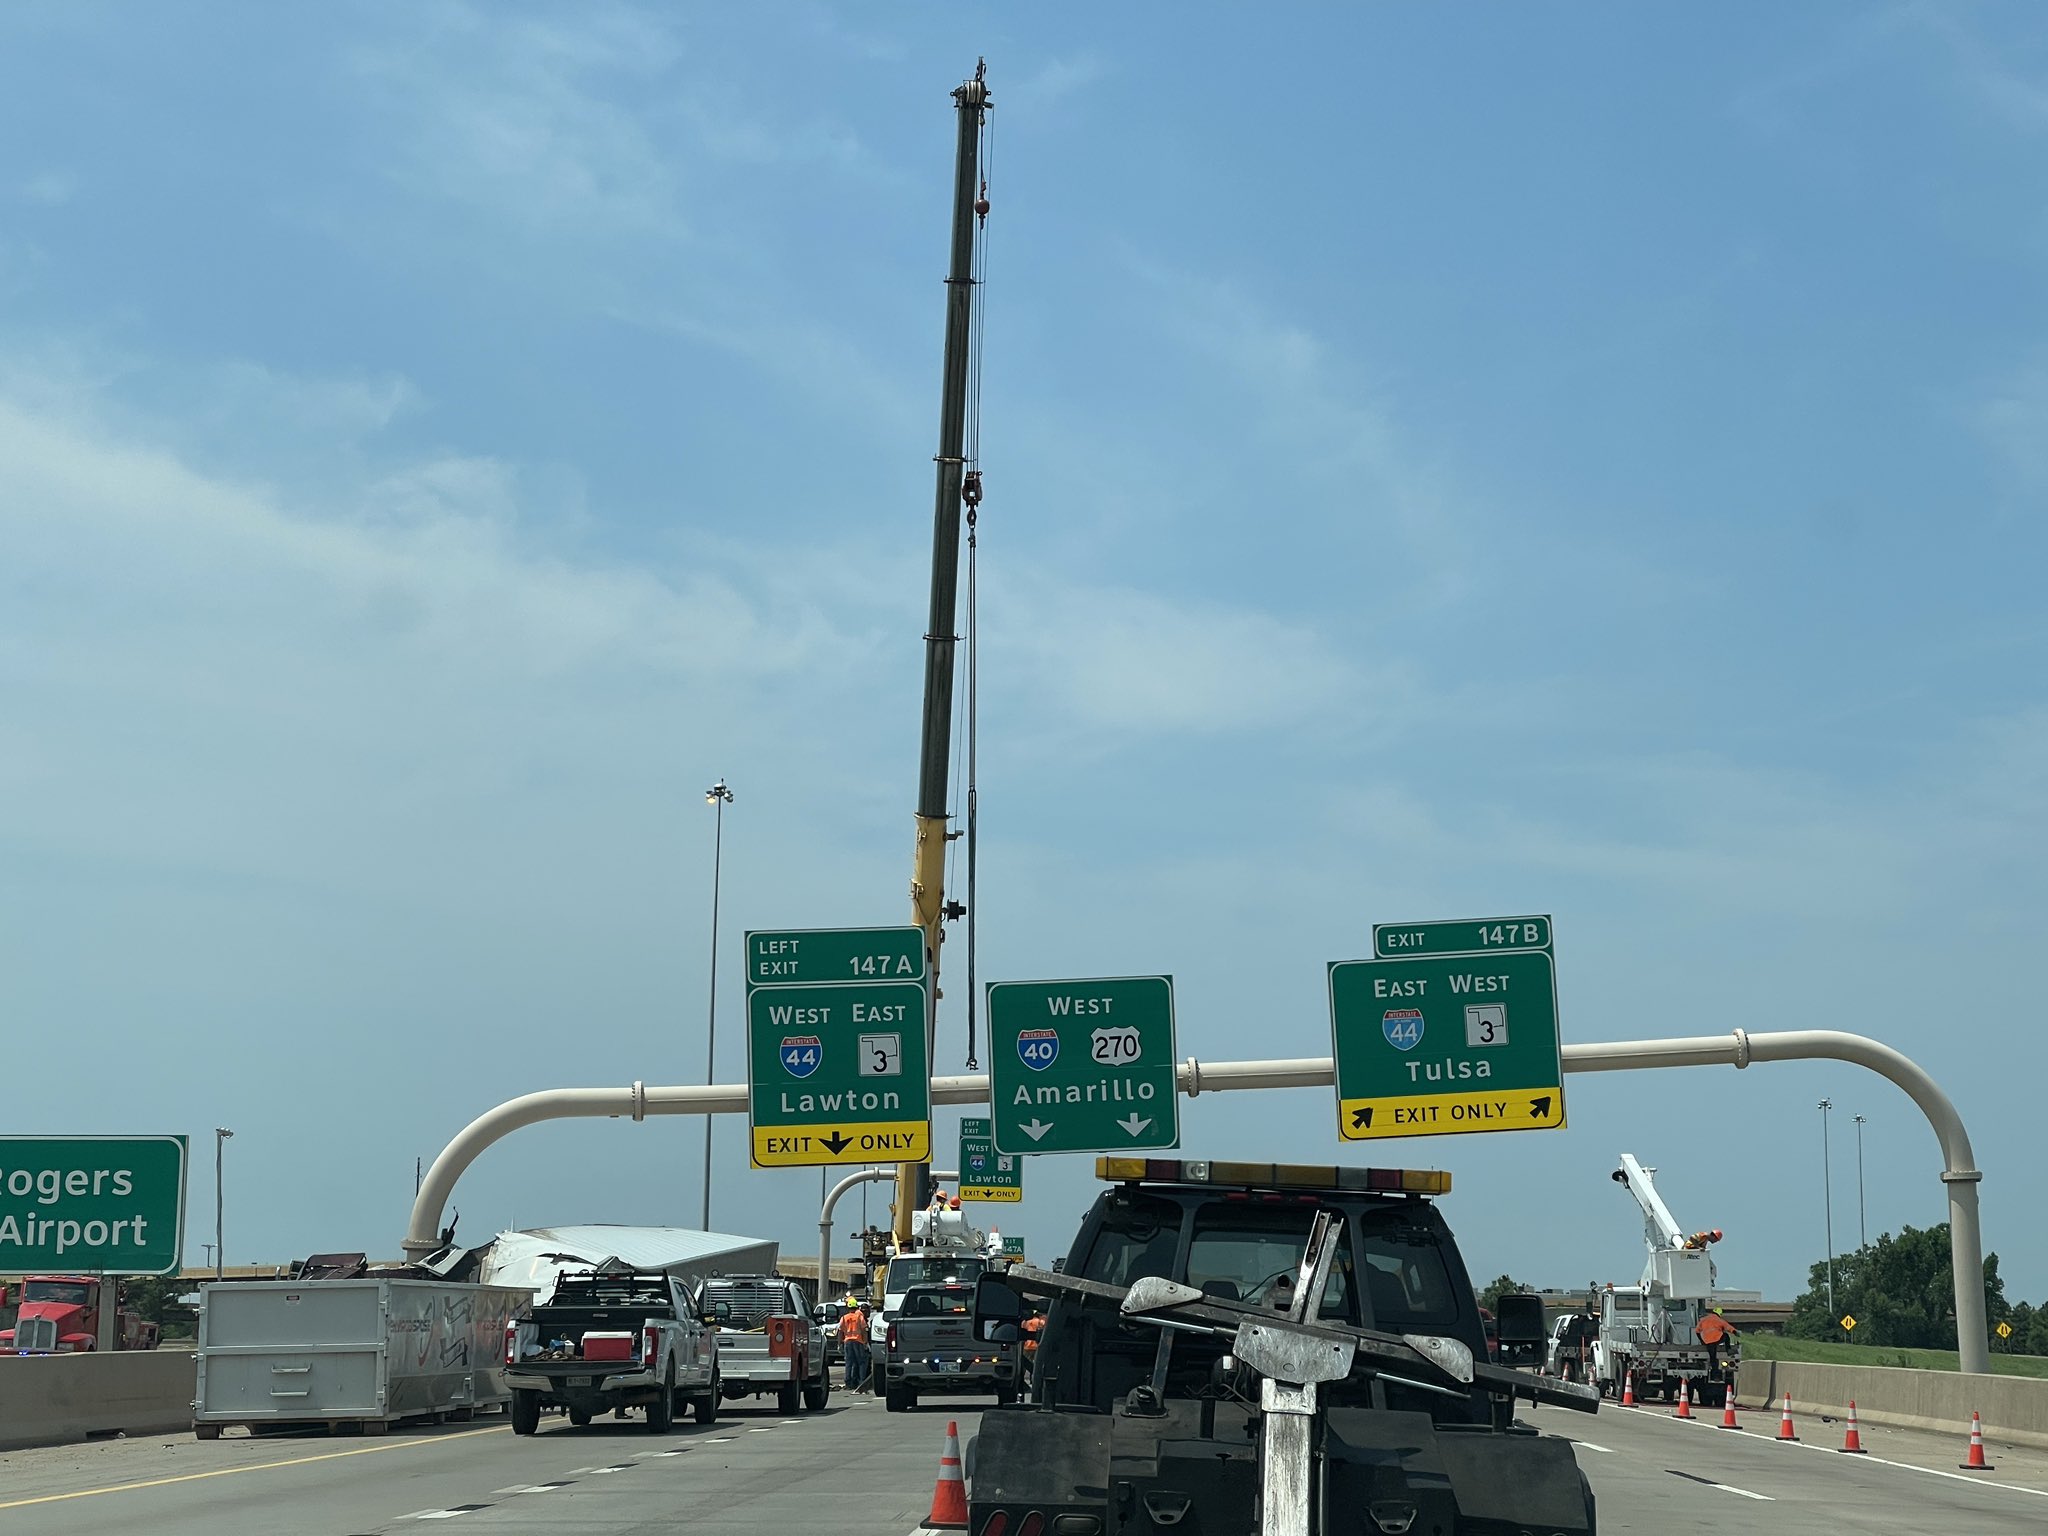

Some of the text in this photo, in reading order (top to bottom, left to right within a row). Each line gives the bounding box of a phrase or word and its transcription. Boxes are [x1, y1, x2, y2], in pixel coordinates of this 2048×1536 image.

[1387, 923, 1539, 947] EXIT 147B
[759, 940, 799, 954] LEFT
[760, 955, 913, 975] EXIT 147A
[1374, 974, 1510, 998] EAST WEST
[769, 1003, 906, 1025] WEST EAST
[1048, 997, 1113, 1016] WEST
[1390, 1022, 1418, 1042] 44
[1479, 1020, 1495, 1043] 3
[785, 1049, 816, 1066] 44
[1024, 1034, 1137, 1060] 40 270
[873, 1050, 888, 1073] 3
[1405, 1057, 1492, 1082] Tulsa
[781, 1090, 899, 1113] Lawton
[1013, 1079, 1154, 1105] Amarillo
[1394, 1102, 1507, 1124] EXIT ONLY
[767, 1133, 915, 1153] EXIT ONLY
[967, 1144, 990, 1152] WEST
[1002, 1162, 1008, 1170] 3
[0, 1168, 133, 1205] ogers
[969, 1174, 1012, 1183] Lawton
[996, 1190, 1016, 1198] ONLY
[0, 1212, 148, 1254] Airport
